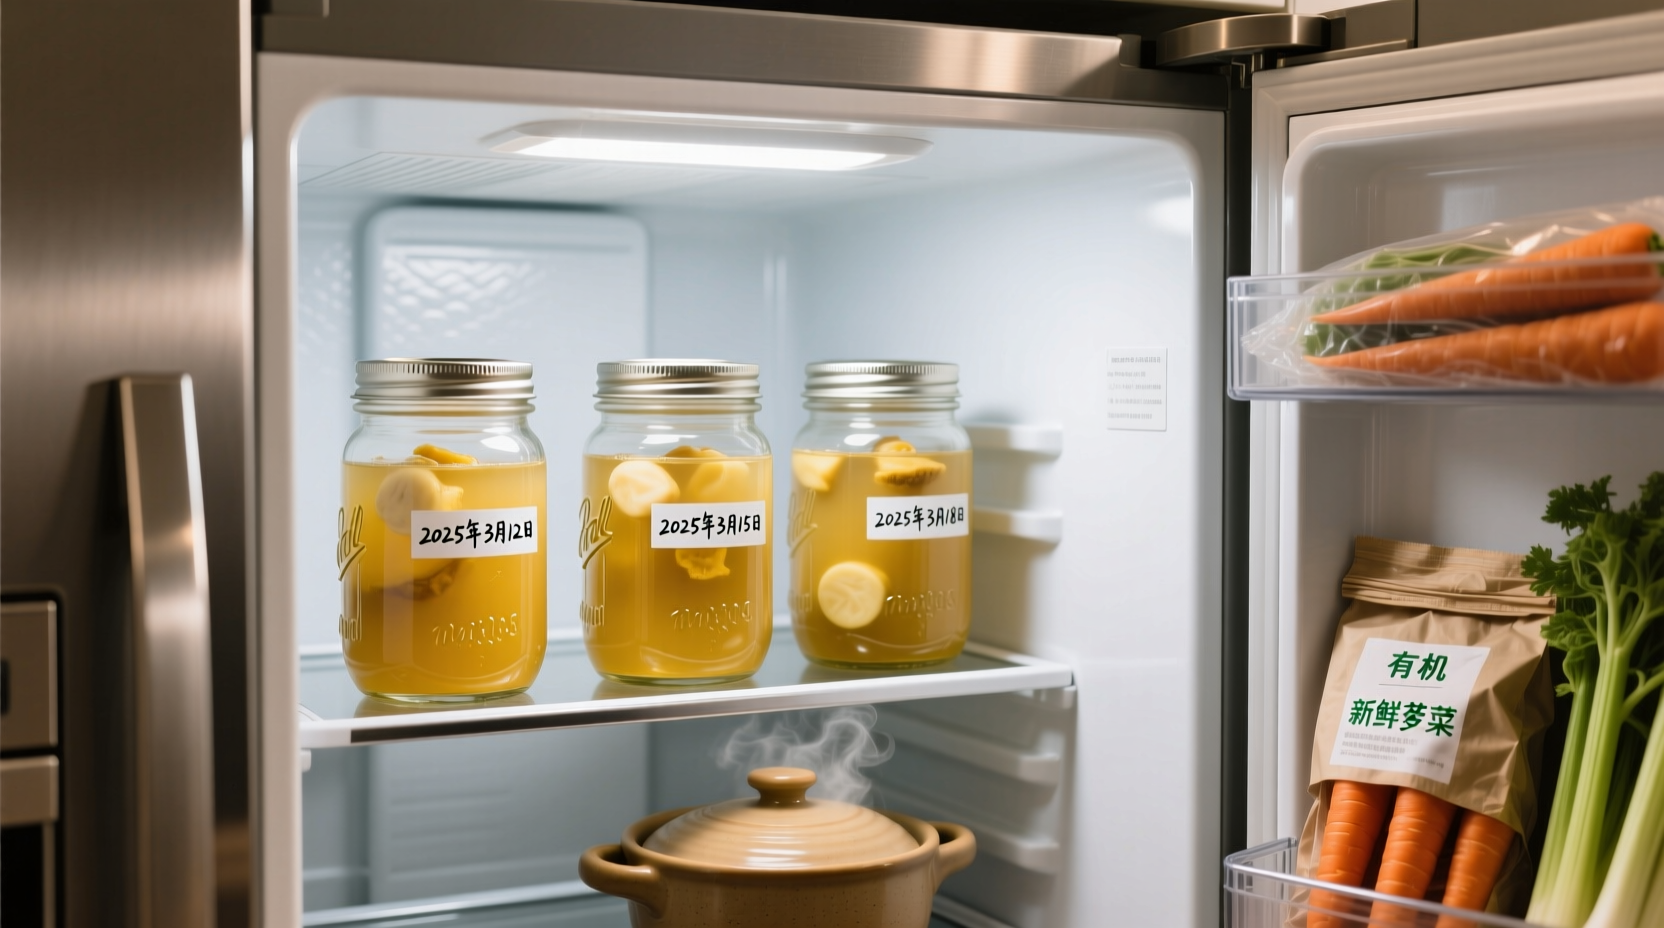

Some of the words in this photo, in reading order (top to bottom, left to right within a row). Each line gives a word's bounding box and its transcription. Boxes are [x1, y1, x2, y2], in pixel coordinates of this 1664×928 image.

[658, 511, 761, 540] 2025年3月15日
[875, 505, 964, 531] 2025年3月18日
[418, 518, 534, 549] 2025年3月12日
[1388, 650, 1448, 682] 有机
